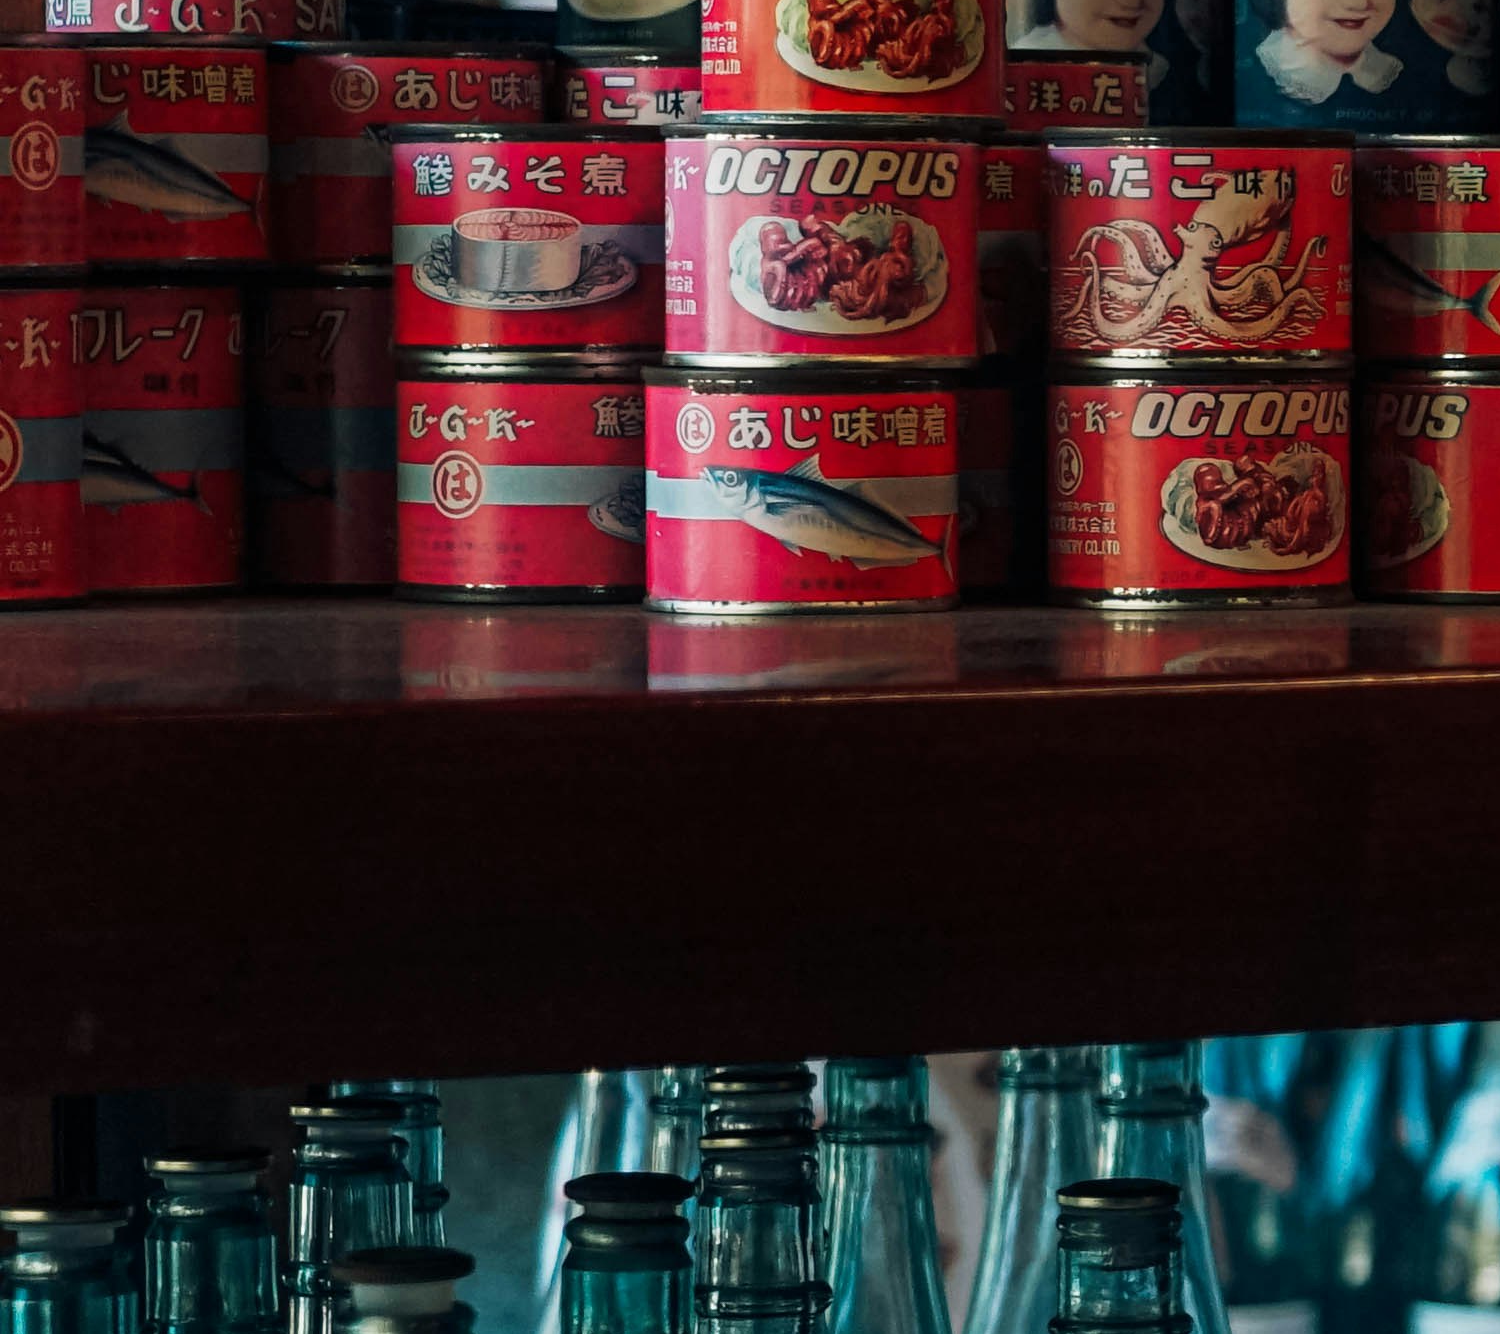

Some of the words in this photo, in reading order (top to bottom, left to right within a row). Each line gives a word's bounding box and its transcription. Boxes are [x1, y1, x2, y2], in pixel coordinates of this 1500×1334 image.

[412, 153, 628, 198] 鯵みそ煮
[704, 148, 957, 197] OCTOPUS
[728, 404, 946, 451] あじ味噌煮
[1131, 390, 1350, 439] OCTOPUS
